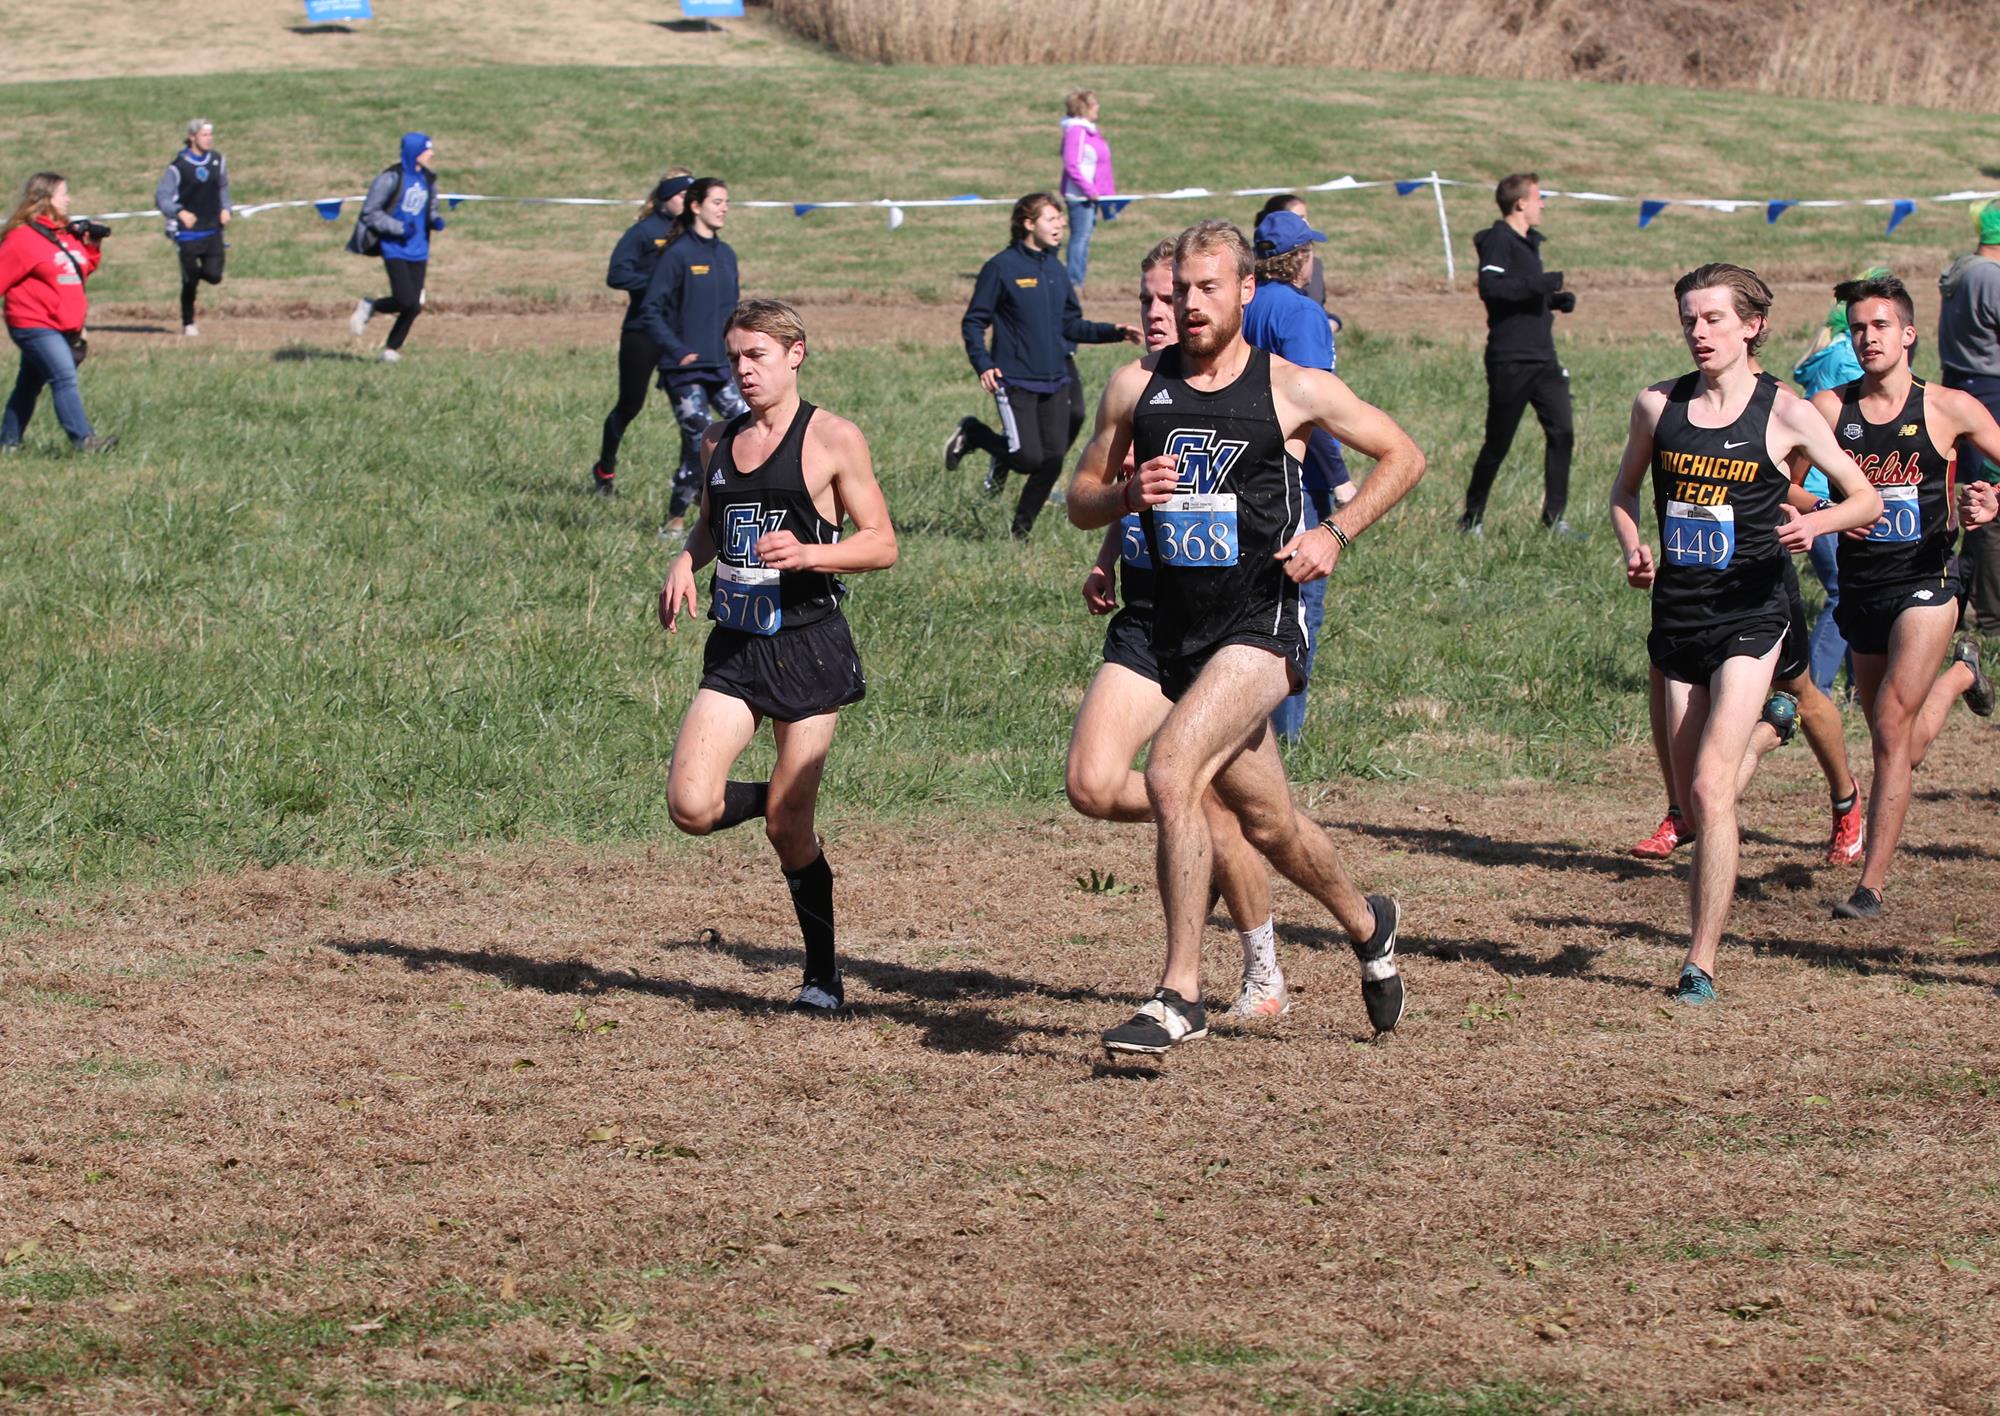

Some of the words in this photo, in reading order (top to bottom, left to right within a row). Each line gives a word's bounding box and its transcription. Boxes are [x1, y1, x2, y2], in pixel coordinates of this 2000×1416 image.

[1163, 427, 1250, 495] GV
[1661, 450, 1760, 483] MICHIGAN
[1675, 480, 1729, 506] TECH
[1159, 521, 1232, 562] 368
[1666, 527, 1730, 565] 449
[714, 588, 777, 631] 370
